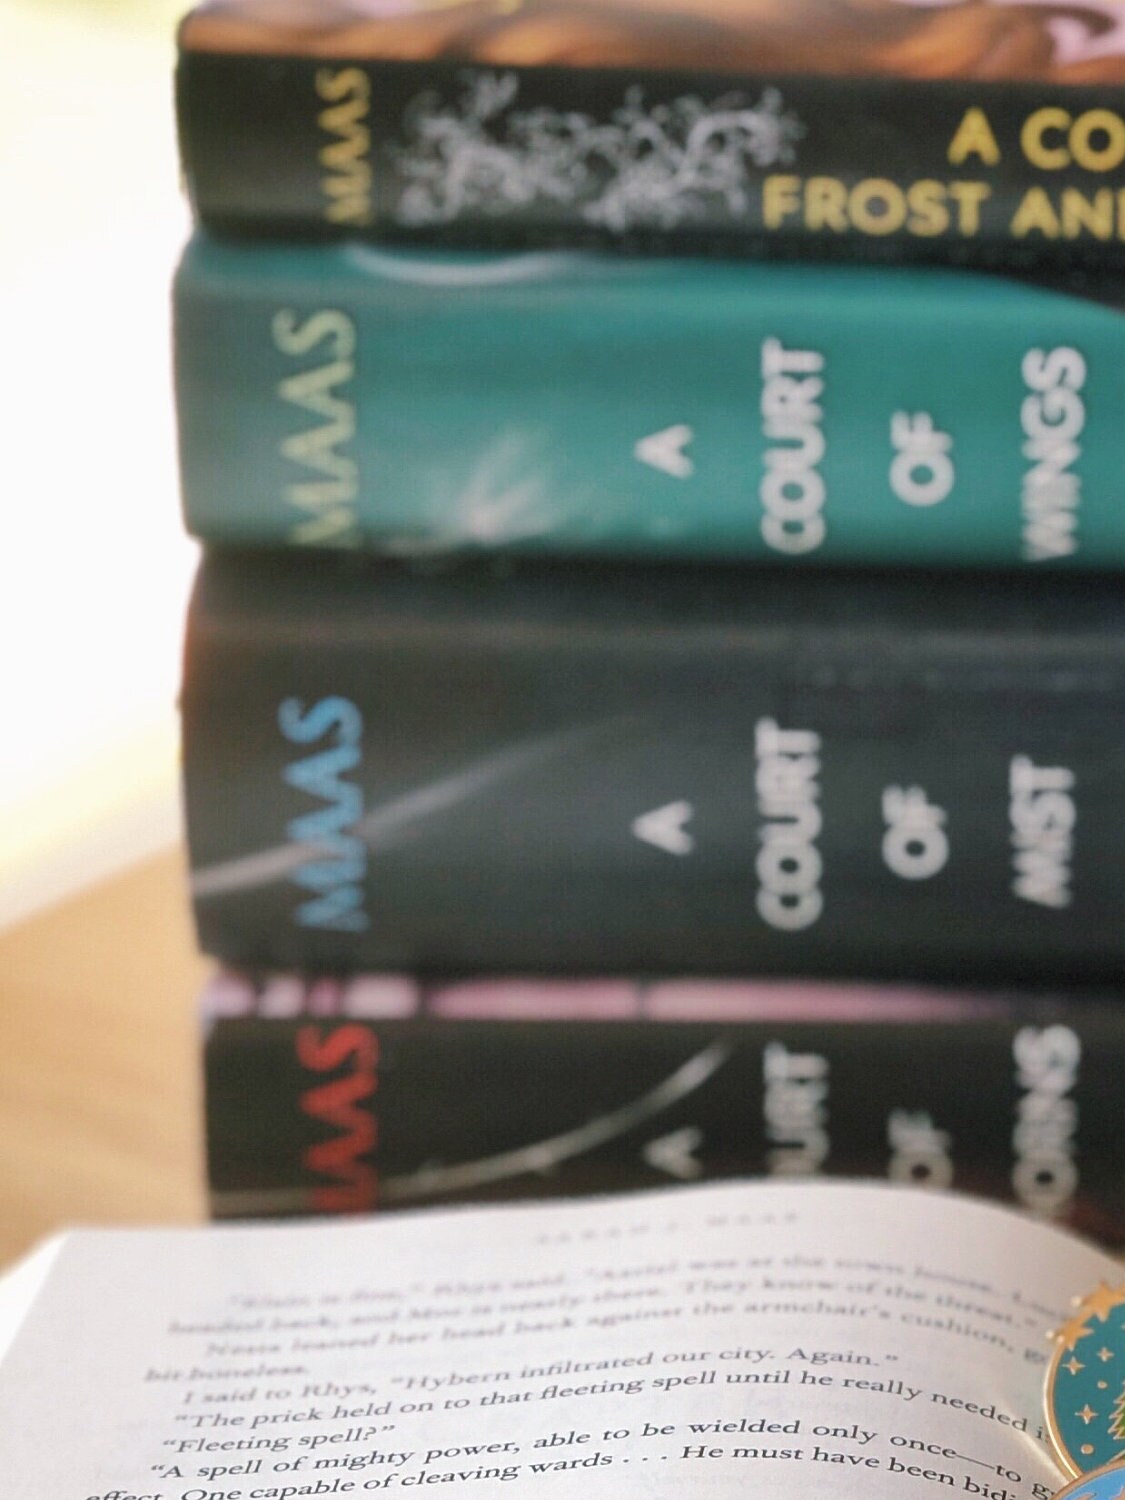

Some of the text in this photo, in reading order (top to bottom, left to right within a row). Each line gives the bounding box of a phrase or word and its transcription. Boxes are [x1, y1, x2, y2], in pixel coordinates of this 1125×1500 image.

[948, 108, 1000, 164] A
[763, 175, 989, 235] FROST
[273, 310, 358, 546] MAAS
[634, 424, 693, 479] A
[760, 338, 826, 553] COURT
[889, 412, 955, 505] OF
[1021, 347, 1086, 559] WINGS
[279, 697, 368, 930] MAAS
[630, 801, 693, 855] A
[754, 718, 823, 930] COURT
[881, 786, 948, 879] OF
[196, 1459, 263, 1482] spell
[272, 1455, 309, 1473] of
[312, 1450, 415, 1471] mighty
[423, 1441, 521, 1465] power,
[533, 1430, 591, 1449] able
[602, 1429, 631, 1441] to
[640, 1422, 676, 1437] be
[687, 1418, 801, 1435] wielded
[812, 1424, 878, 1445] only
[362, 1472, 400, 1490] of
[400, 1465, 522, 1487] cleaving
[528, 1451, 613, 1474] wards
[679, 1445, 724, 1459] He
[731, 1448, 804, 1461] must
[810, 1446, 881, 1469] have
[887, 1456, 955, 1487] been
